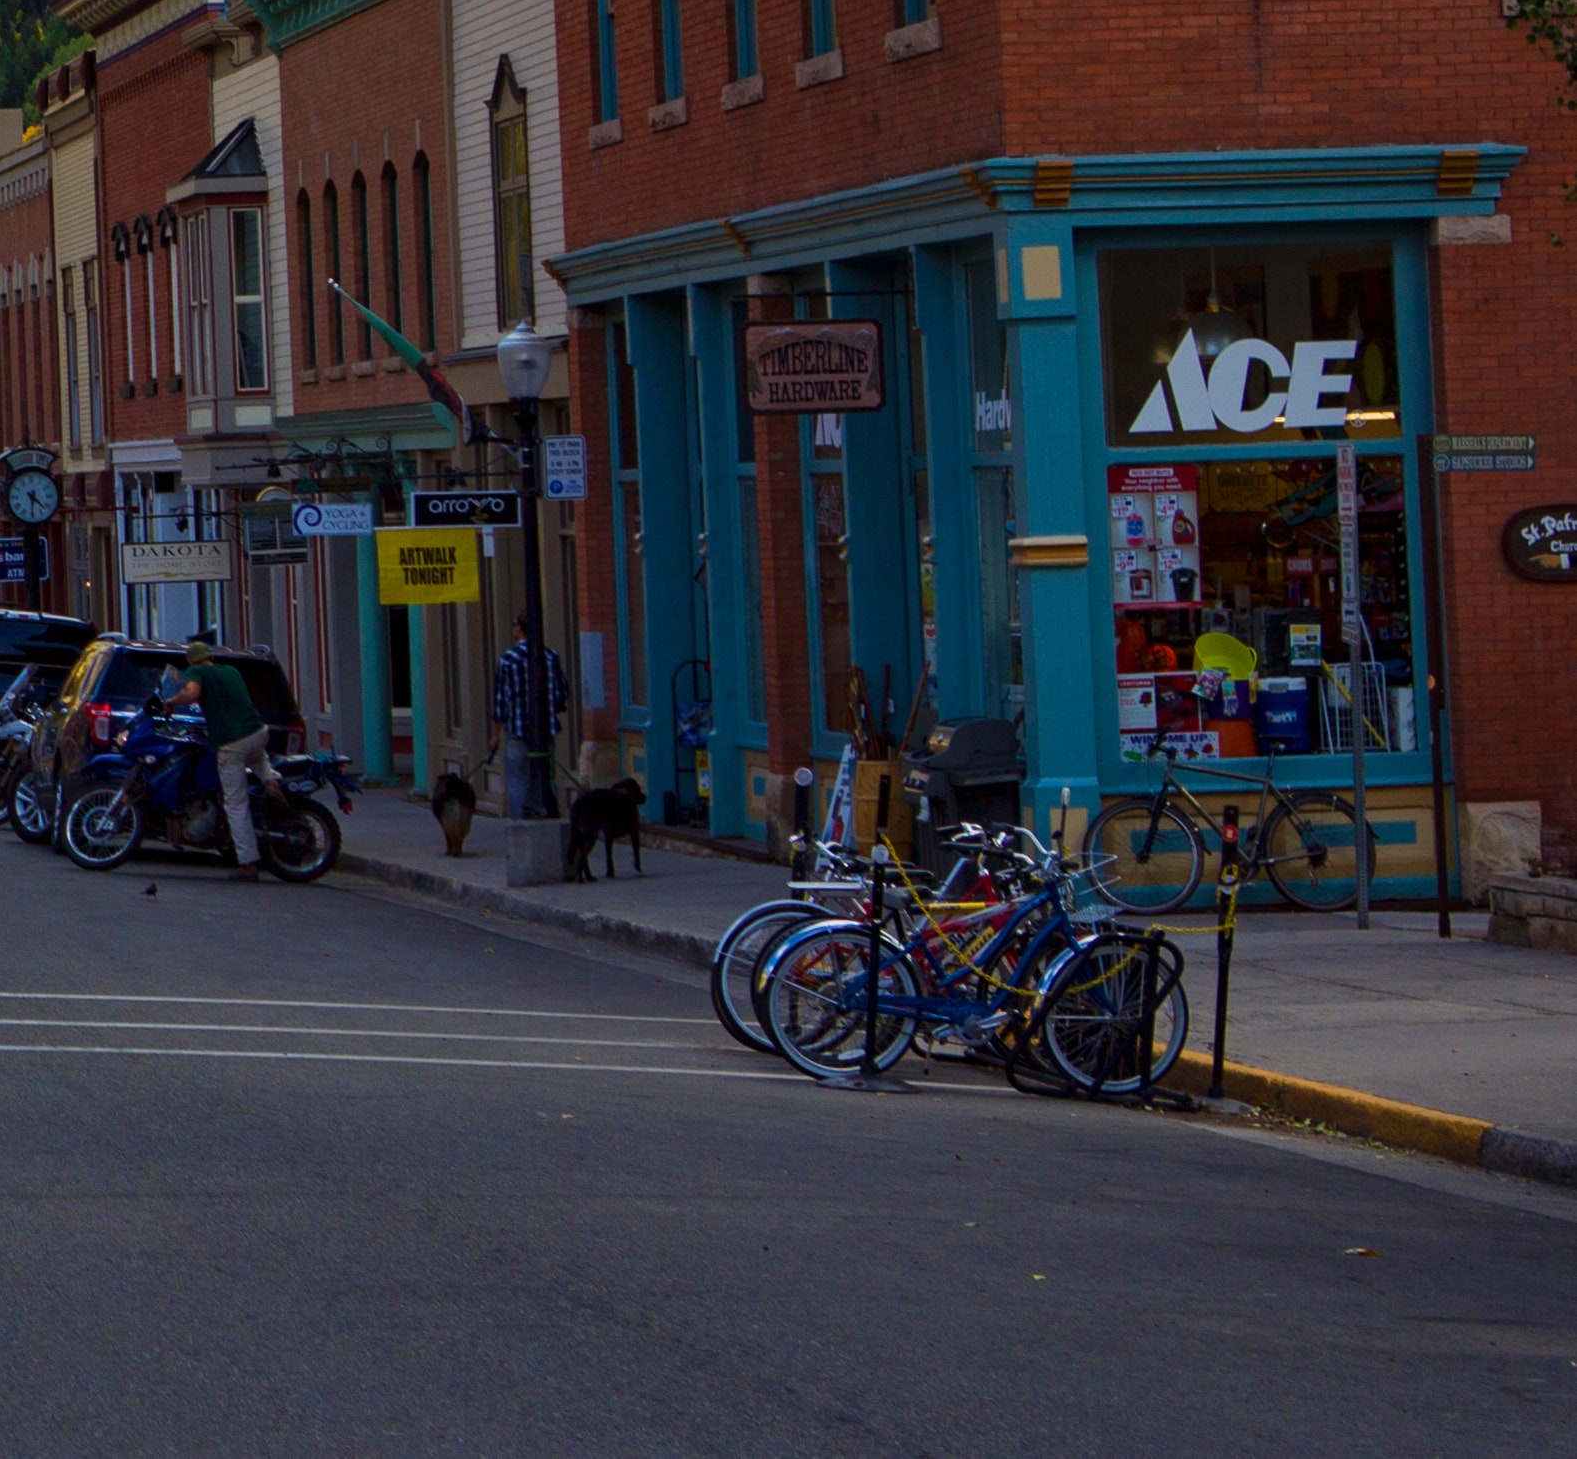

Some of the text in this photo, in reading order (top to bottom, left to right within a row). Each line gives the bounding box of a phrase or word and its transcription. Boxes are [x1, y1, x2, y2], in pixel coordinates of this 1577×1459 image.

[758, 340, 869, 376] TIMBERLINE
[1129, 327, 1358, 433] ACE
[768, 380, 862, 404] HARDWARE
[1487, 436, 1527, 450] DEPARTMENT
[1451, 456, 1526, 470] SAPSUCKER STUDIOS
[324, 510, 359, 518] YOGA
[427, 498, 506, 519] arroyo
[321, 520, 369, 530] CYCLING
[5, 552, 23, 562] ba
[131, 544, 222, 558] DAKOTA
[399, 546, 457, 566] ARTWALK
[189, 560, 222, 568] STORE
[403, 566, 455, 585] TONIGHT
[1168, 734, 1187, 743] ME
[1190, 734, 1208, 742] UP
